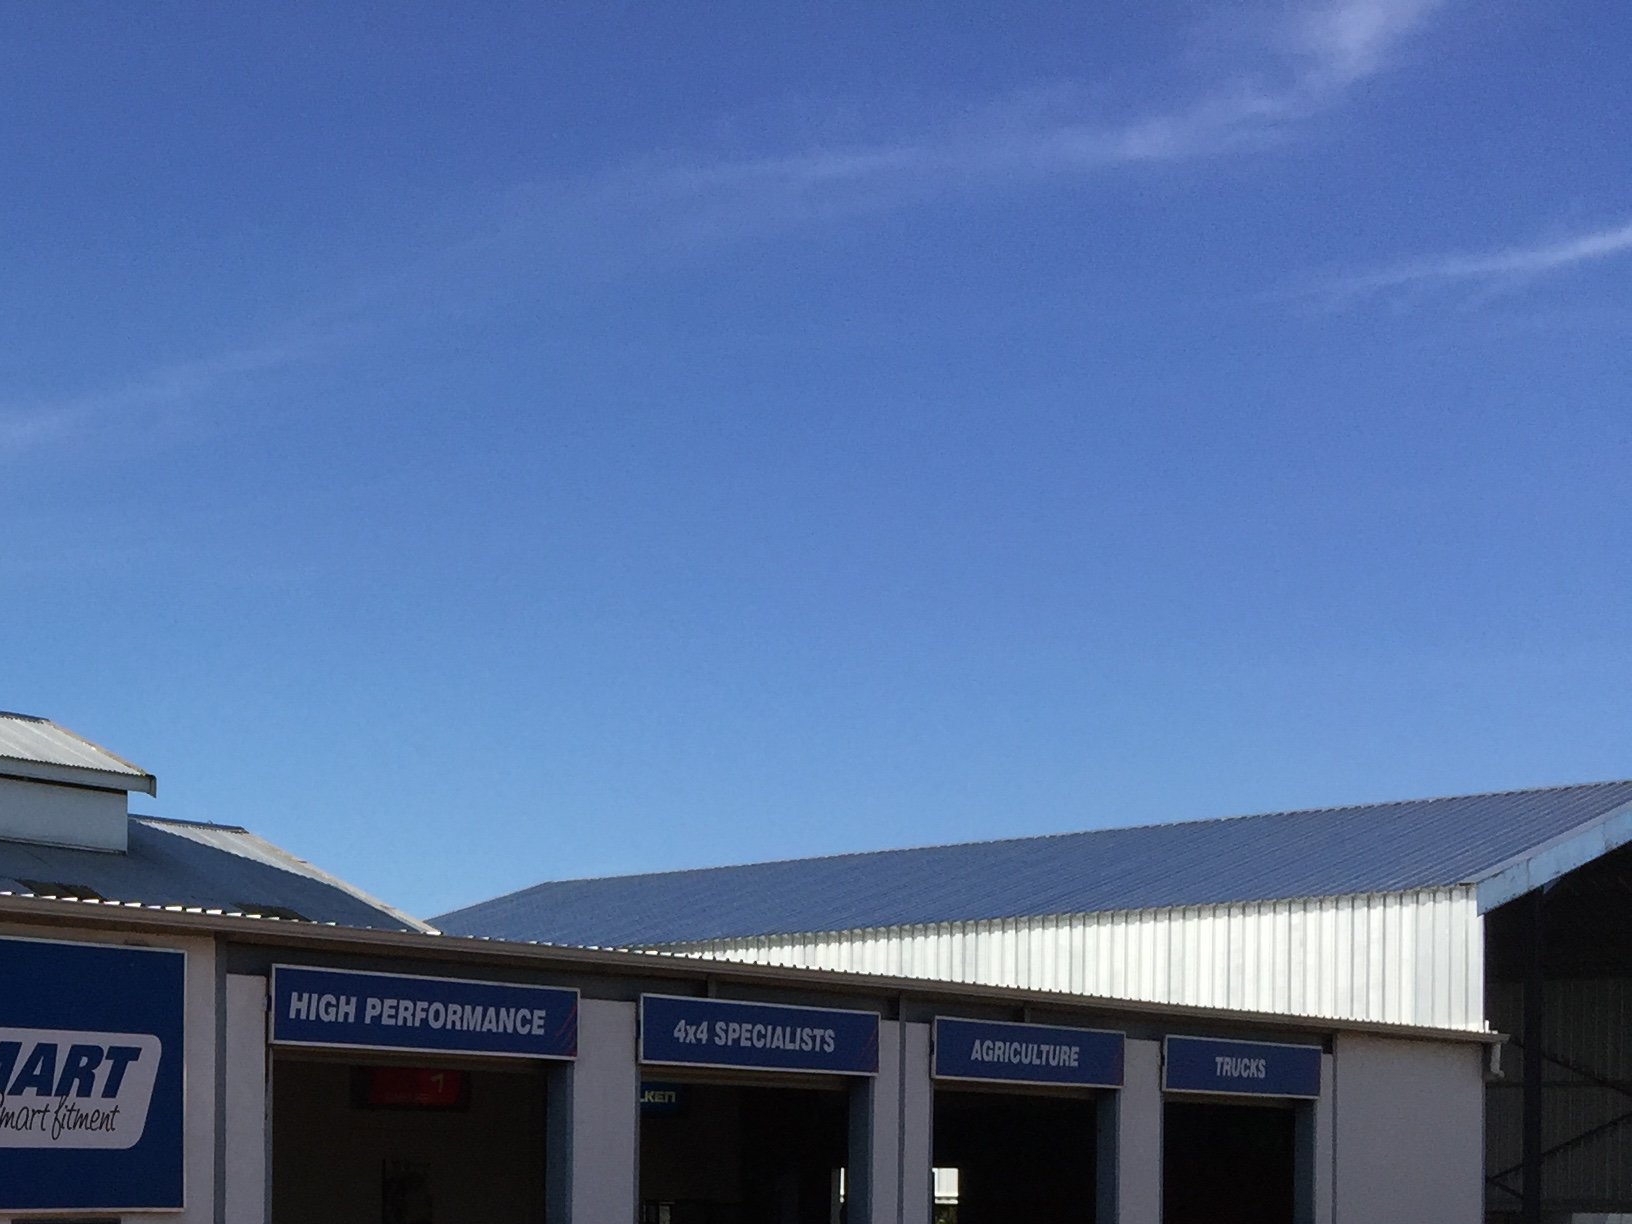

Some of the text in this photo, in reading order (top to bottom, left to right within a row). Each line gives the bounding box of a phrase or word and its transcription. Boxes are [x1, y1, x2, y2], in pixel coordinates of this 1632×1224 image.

[288, 991, 547, 1036] HIGH PERFORMANCE
[673, 1019, 836, 1053] 4x4 SPECIALISTS
[970, 1039, 1080, 1067] AGRICULTURE
[1215, 1056, 1267, 1079] TRUCKS
[51, 1094, 120, 1140] fitment
